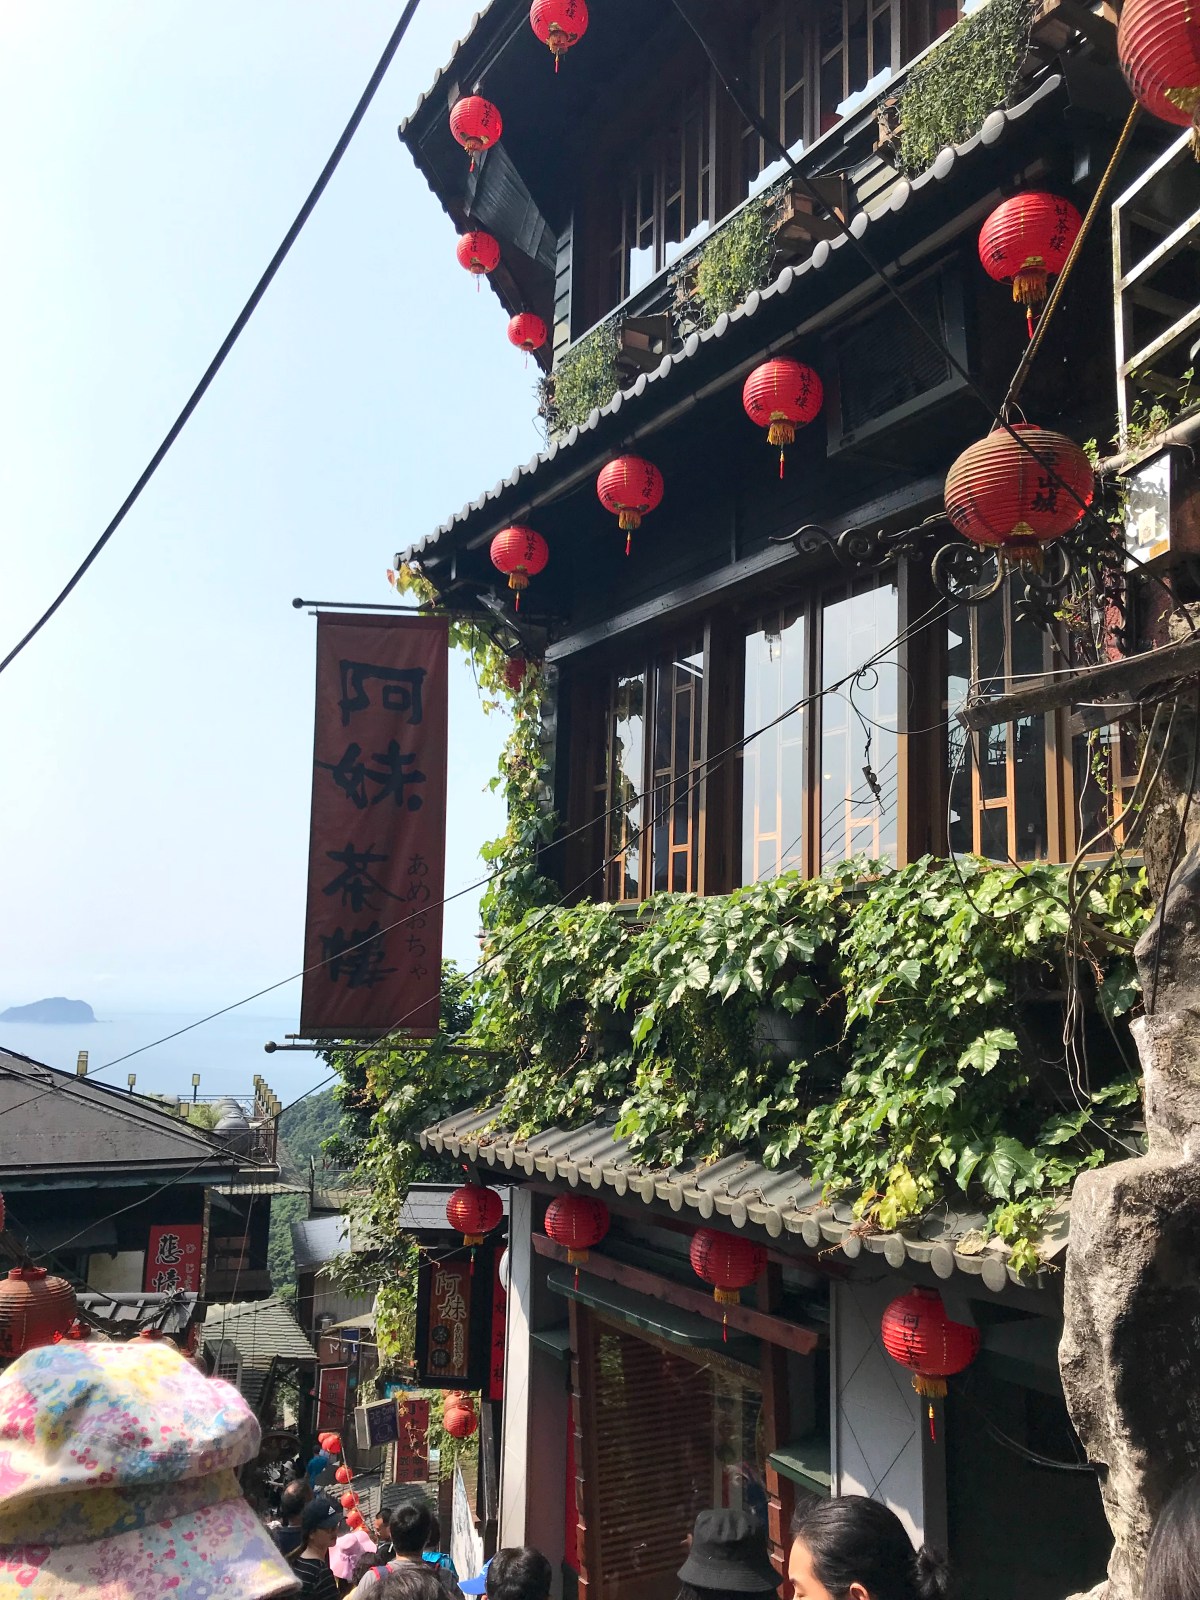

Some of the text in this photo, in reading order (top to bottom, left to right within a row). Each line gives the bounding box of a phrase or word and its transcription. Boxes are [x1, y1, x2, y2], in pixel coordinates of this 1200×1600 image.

[314, 658, 428, 990] 阿妹茶樓
[435, 1271, 466, 1322] 阿妹
